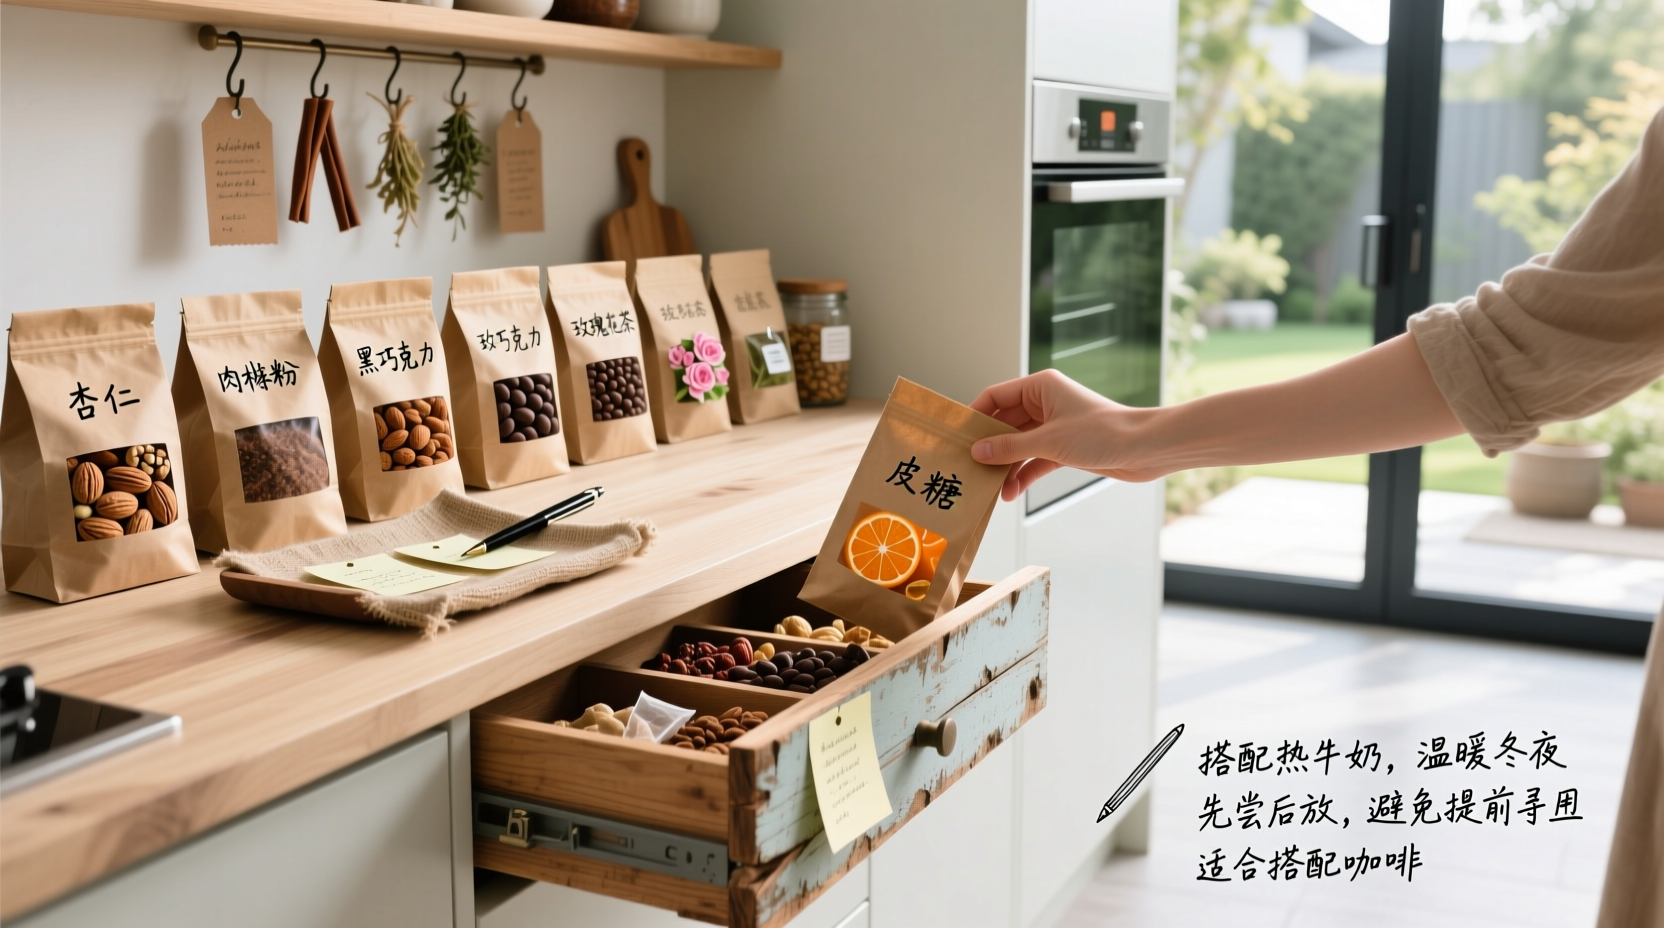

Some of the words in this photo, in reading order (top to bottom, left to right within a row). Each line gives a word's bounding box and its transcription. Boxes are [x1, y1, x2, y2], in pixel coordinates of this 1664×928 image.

[356, 340, 434, 376] 黑巧克力
[69, 381, 140, 421] 杏仁
[885, 455, 963, 510] 皮糖
